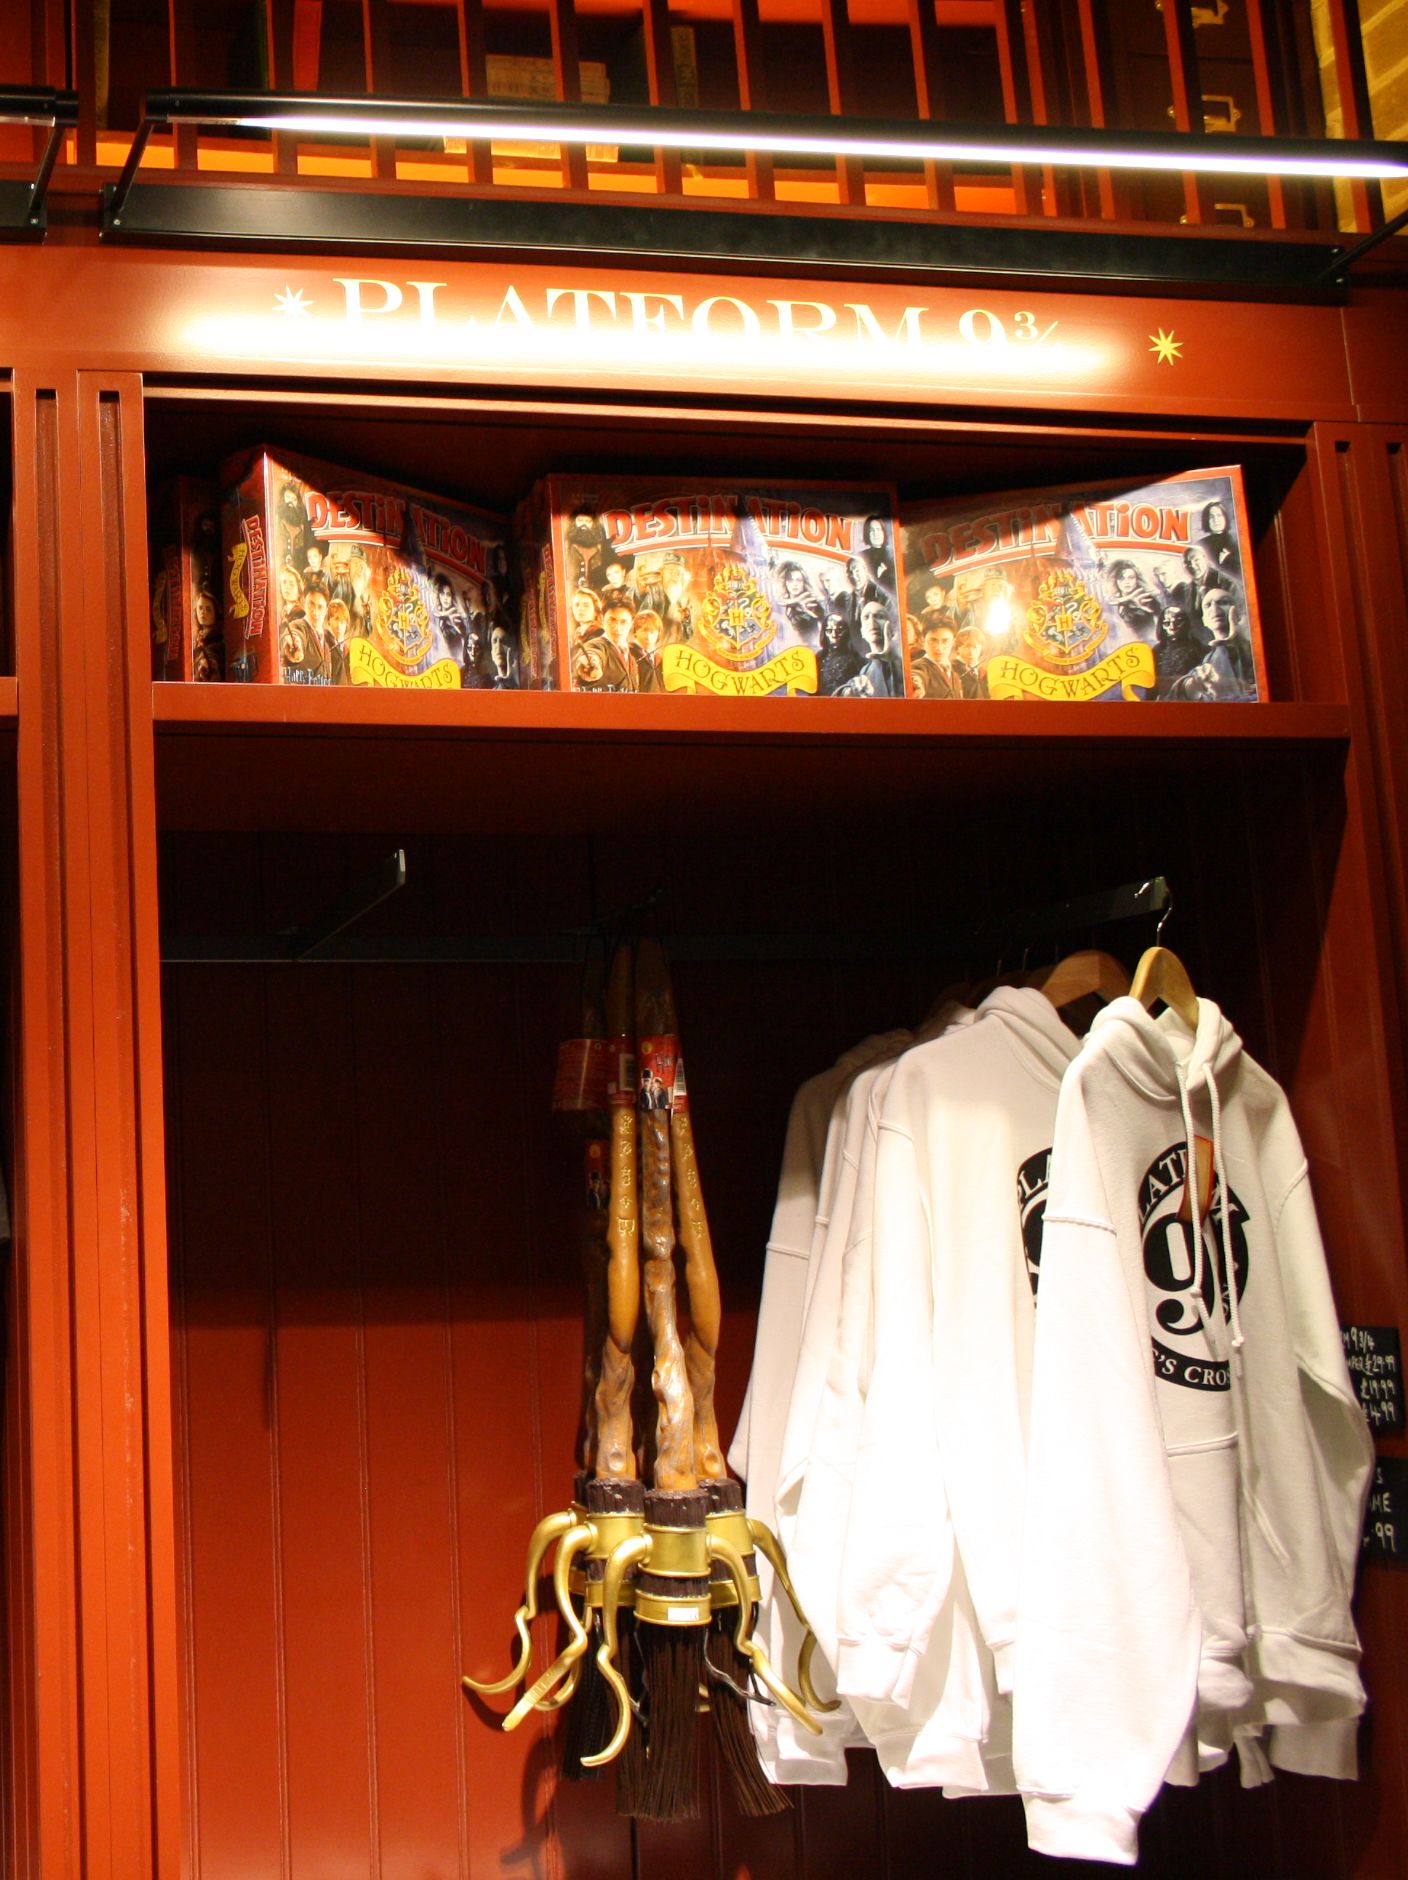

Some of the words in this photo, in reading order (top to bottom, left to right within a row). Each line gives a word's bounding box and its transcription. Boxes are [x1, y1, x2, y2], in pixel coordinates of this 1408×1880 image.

[332, 277, 930, 352] PLATFORM
[676, 650, 805, 695] HOGWARTS
[1000, 647, 1141, 699] HOGWARTS
